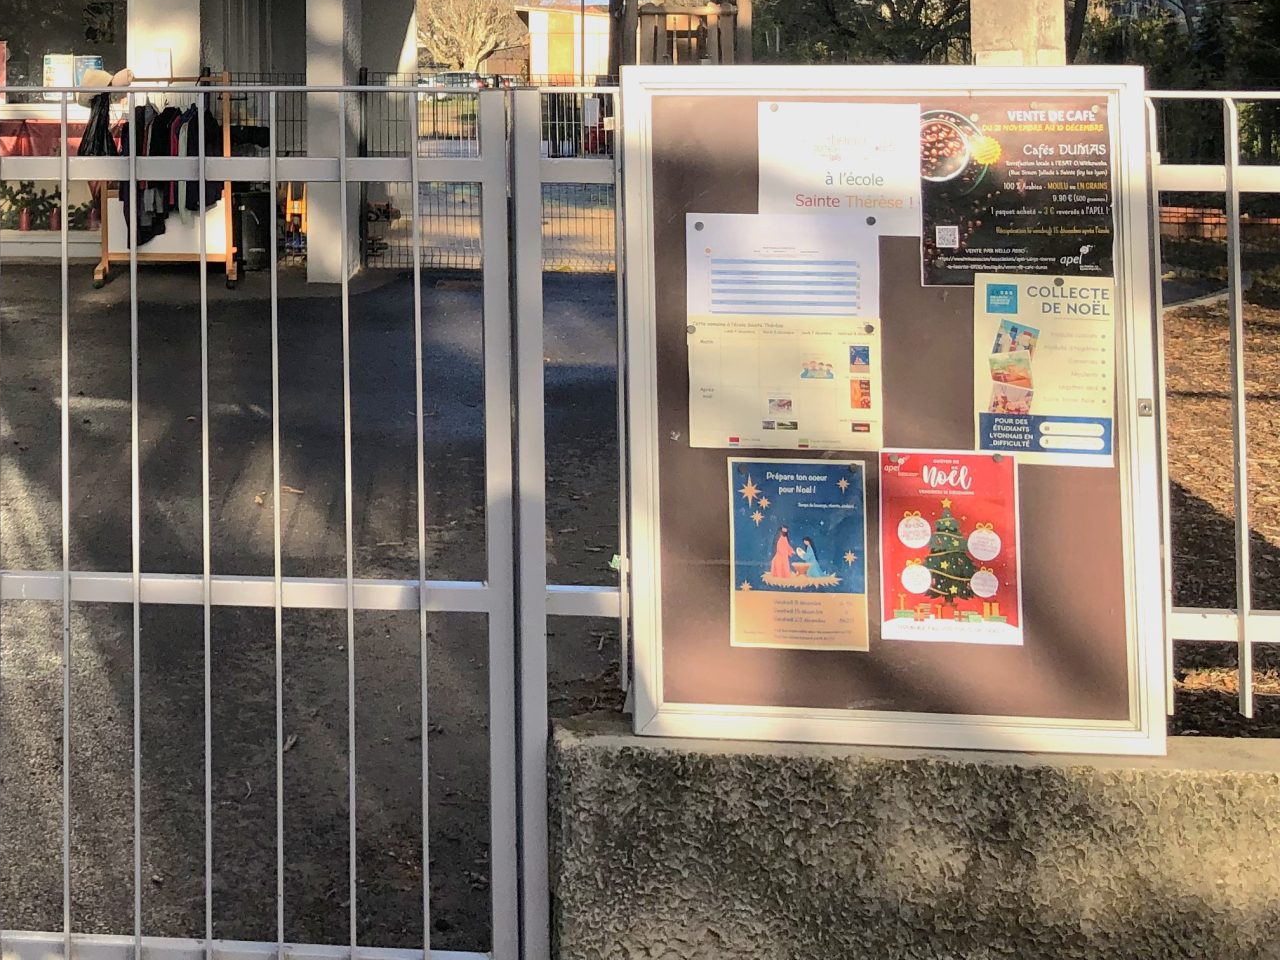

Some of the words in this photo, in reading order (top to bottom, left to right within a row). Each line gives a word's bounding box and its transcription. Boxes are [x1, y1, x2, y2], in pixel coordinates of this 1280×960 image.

[1007, 110, 1046, 122] VENTE
[1048, 110, 1065, 122] DE
[1023, 143, 1055, 158] Cafés
[1059, 143, 1107, 155] DUMAS
[825, 171, 833, 185] à
[839, 172, 884, 186] l'école
[1086, 182, 1108, 190] GRAINS
[795, 194, 840, 207] Sainte
[846, 195, 903, 209] Thérèse
[995, 208, 1015, 217] paquet
[1043, 207, 1048, 215] 3
[1060, 254, 1083, 266] apel
[1026, 285, 1110, 300] COLLECTE
[1041, 302, 1061, 314] DE
[1067, 301, 1110, 316] NOËL
[993, 424, 1030, 432] ÉTUDIANTS
[766, 471, 794, 482] Prépare
[922, 465, 972, 489] Noël
[778, 486, 794, 495] pour
